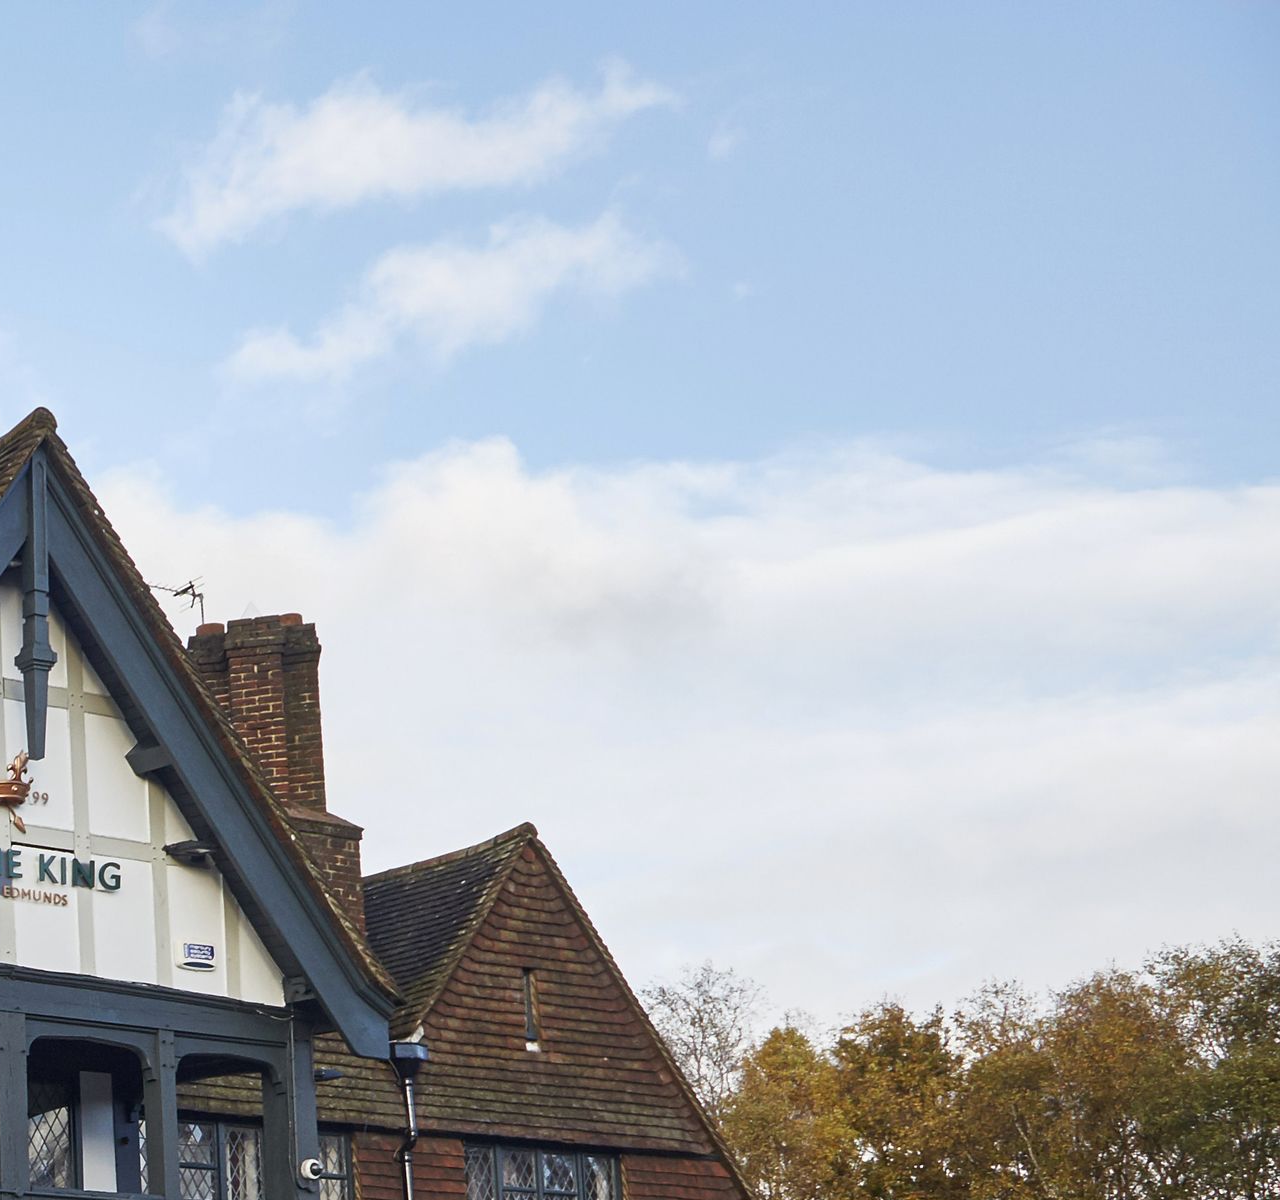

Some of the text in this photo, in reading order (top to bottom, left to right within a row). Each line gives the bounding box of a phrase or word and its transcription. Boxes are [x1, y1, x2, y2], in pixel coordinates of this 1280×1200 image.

[32, 791, 49, 805] 99
[38, 852, 122, 892] KING
[2, 885, 68, 907] EDMUNDS
